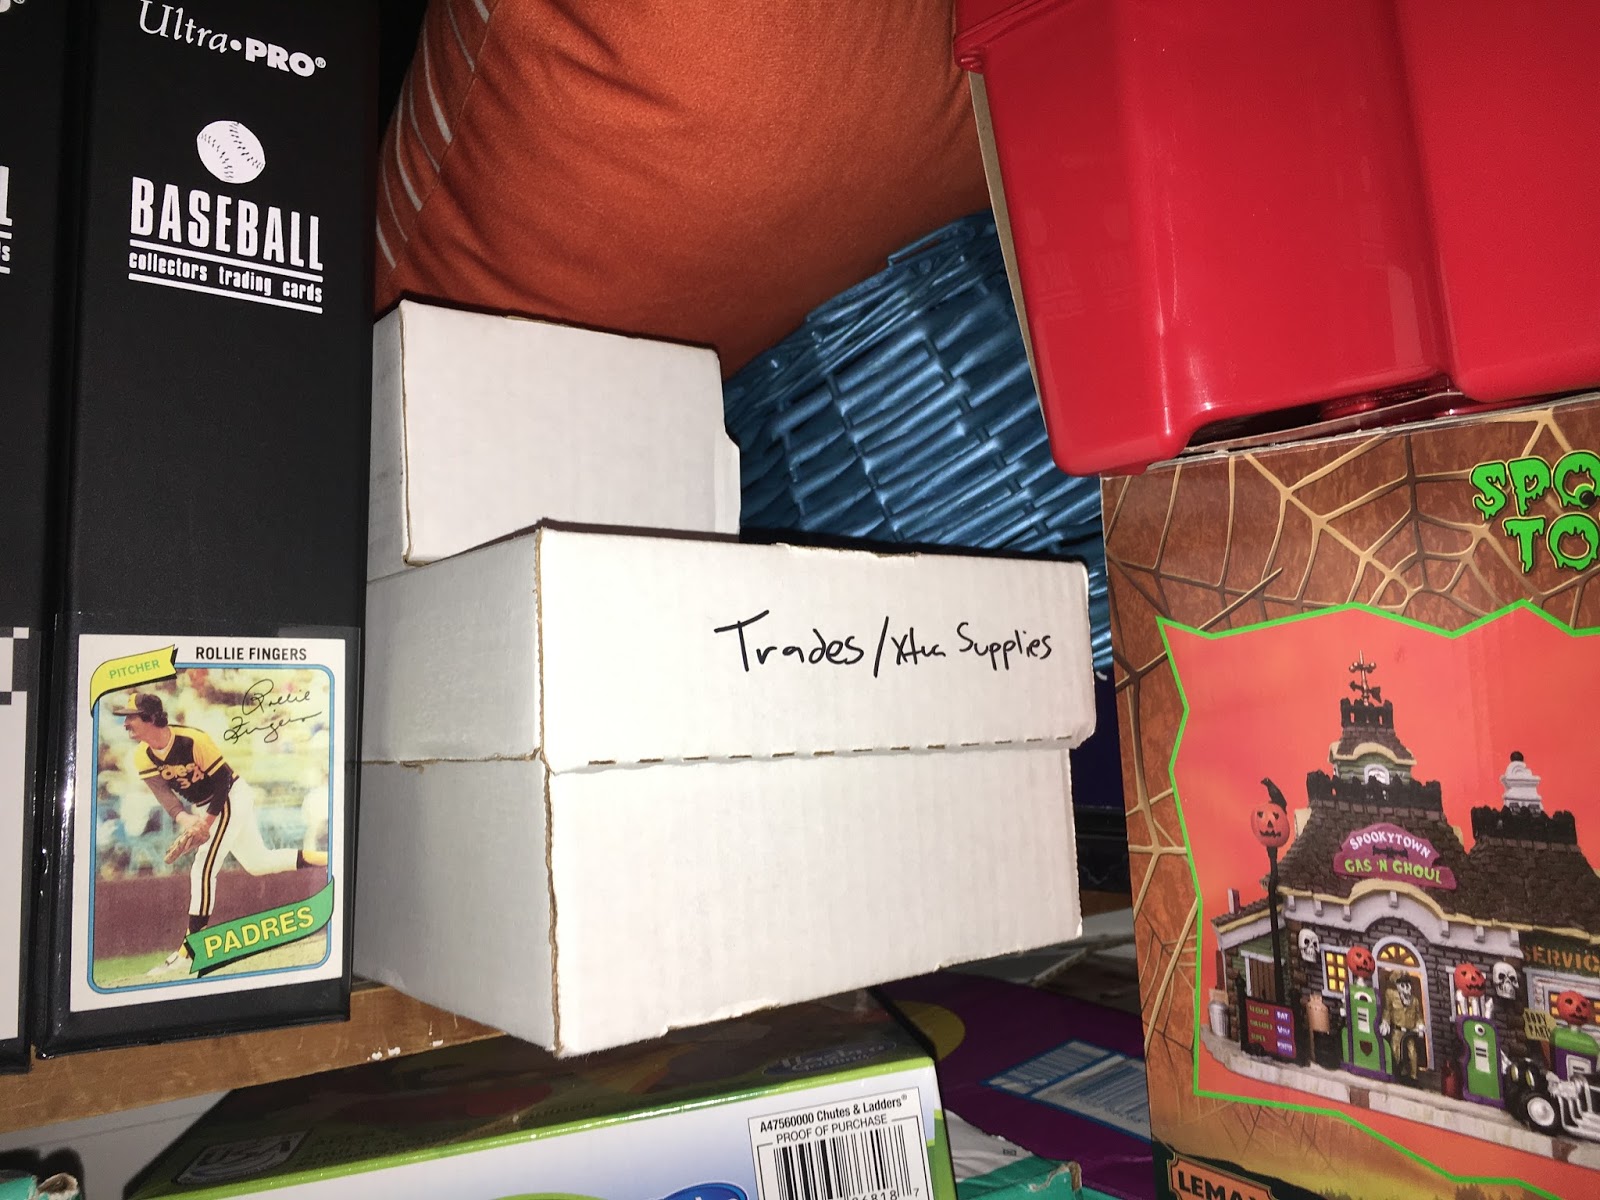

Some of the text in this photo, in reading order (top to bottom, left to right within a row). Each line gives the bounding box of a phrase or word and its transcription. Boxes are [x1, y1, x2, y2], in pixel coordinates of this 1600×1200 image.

[130, 176, 324, 271] BASEBALL
[128, 252, 323, 303] collectors trading cards
[195, 646, 308, 661] ROLLIE FINGERS
[956, 622, 1053, 671] Supplies
[108, 659, 161, 680] PITCHER
[1349, 831, 1431, 859] SPOOKYTOWN
[1344, 858, 1373, 874] GAS
[1392, 859, 1442, 885] GHOUL
[203, 906, 315, 960] PADRES
[760, 1113, 815, 1133] A47560000
[816, 1107, 851, 1123] Chutes
[853, 1104, 861, 1115] &
[776, 1114, 888, 1144] PROOF OF PURCHASE
